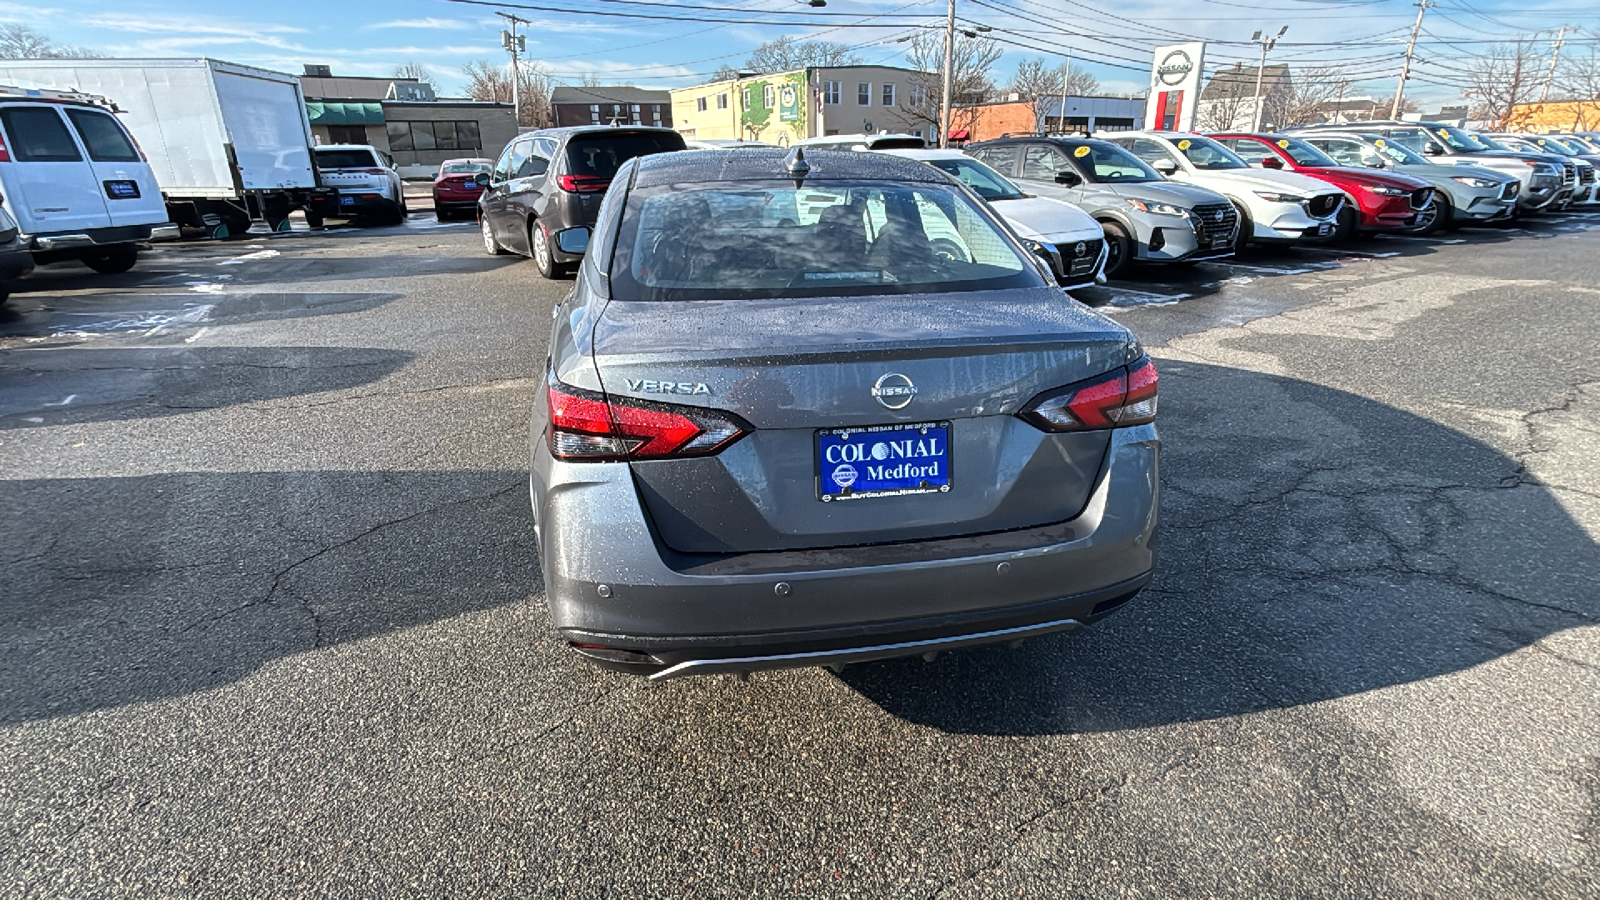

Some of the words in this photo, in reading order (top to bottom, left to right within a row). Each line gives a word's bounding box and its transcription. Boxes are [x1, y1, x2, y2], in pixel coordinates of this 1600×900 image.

[622, 378, 713, 396] VERSA
[870, 386, 919, 397] NISSAN
[832, 427, 867, 435] COLONIAL
[826, 438, 944, 463] COLONIAL
[867, 462, 939, 480] Medford
